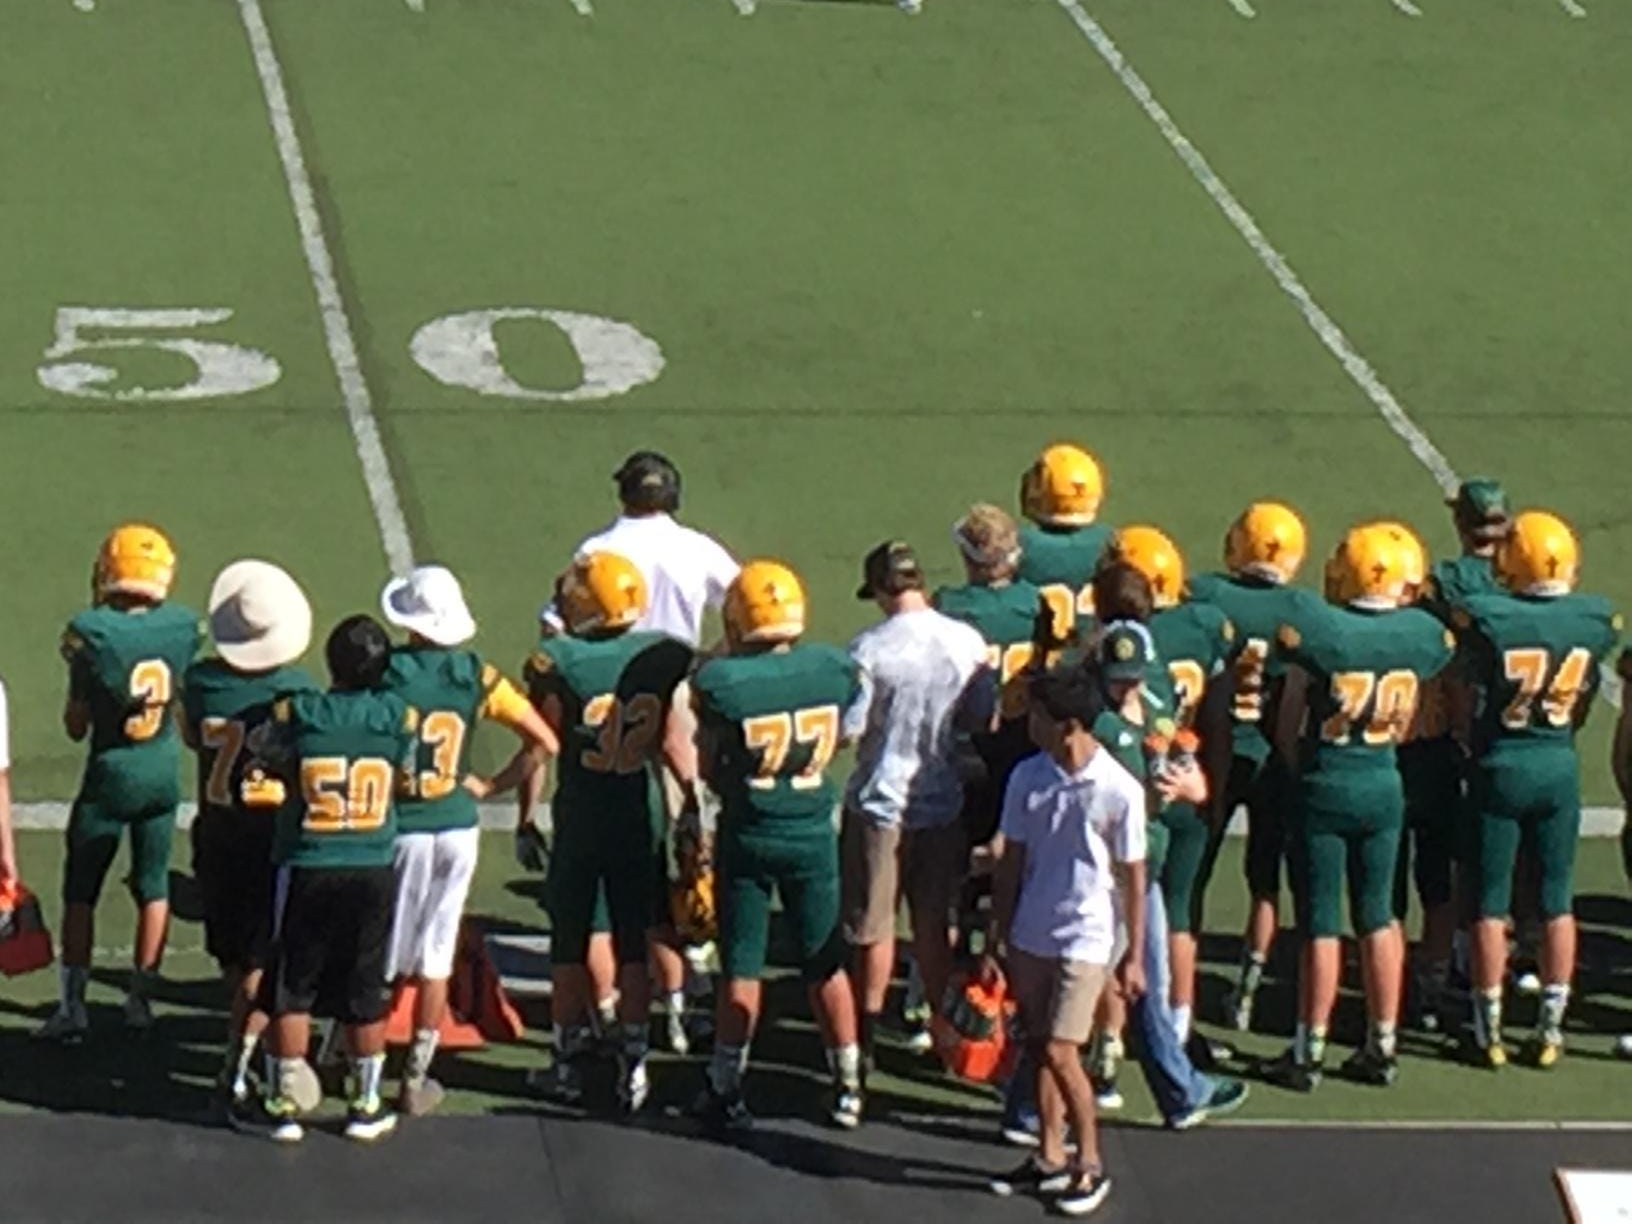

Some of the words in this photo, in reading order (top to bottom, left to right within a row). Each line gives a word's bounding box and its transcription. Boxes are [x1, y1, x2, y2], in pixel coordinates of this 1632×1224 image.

[124, 658, 171, 740] 3
[1502, 643, 1591, 728] 74
[581, 693, 661, 774] 32
[742, 704, 840, 790] 77
[300, 756, 394, 832] 50
